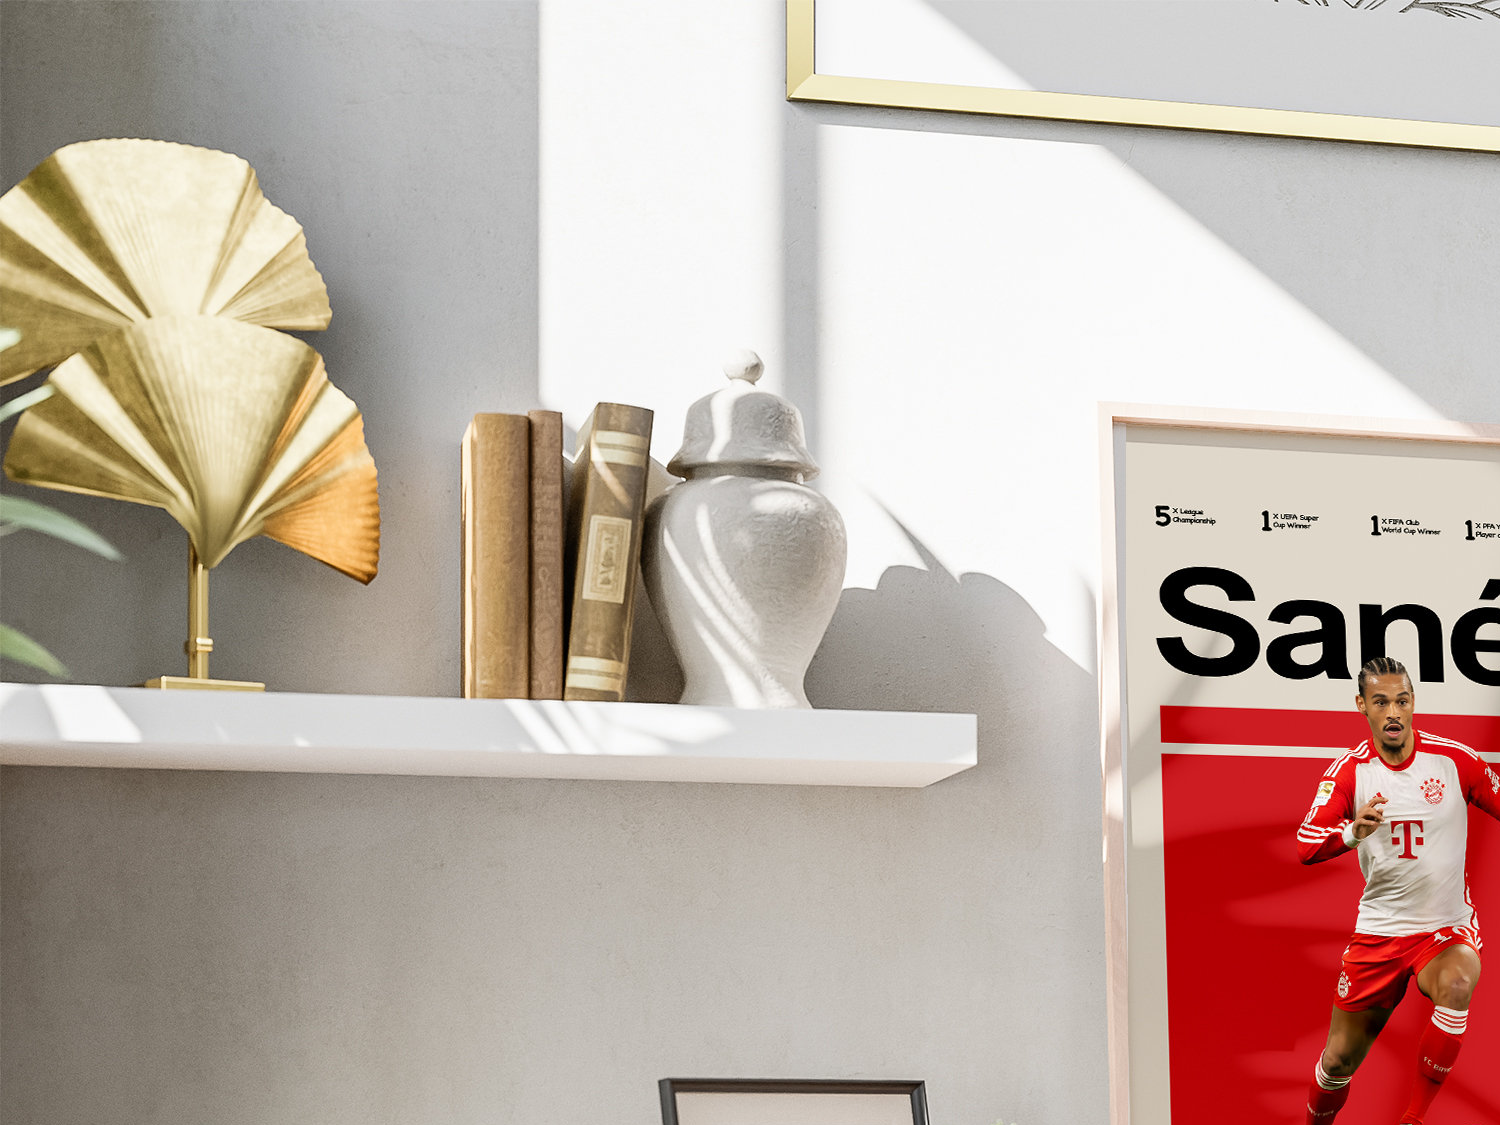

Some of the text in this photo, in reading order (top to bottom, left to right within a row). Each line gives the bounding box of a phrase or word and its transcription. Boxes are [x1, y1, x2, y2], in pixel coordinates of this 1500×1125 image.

[1155, 505, 1171, 527] 5
[1180, 508, 1204, 517] League
[1172, 516, 1216, 526] Championship
[1261, 510, 1272, 531] 1
[1300, 514, 1319, 522] Super
[1273, 521, 1311, 530] Cup Winner
[1371, 515, 1381, 536] 1
[1465, 519, 1476, 541] 1
[1482, 522, 1496, 530] PFA
[1381, 526, 1441, 536] World Cup Winner
[1475, 531, 1497, 539] Player
